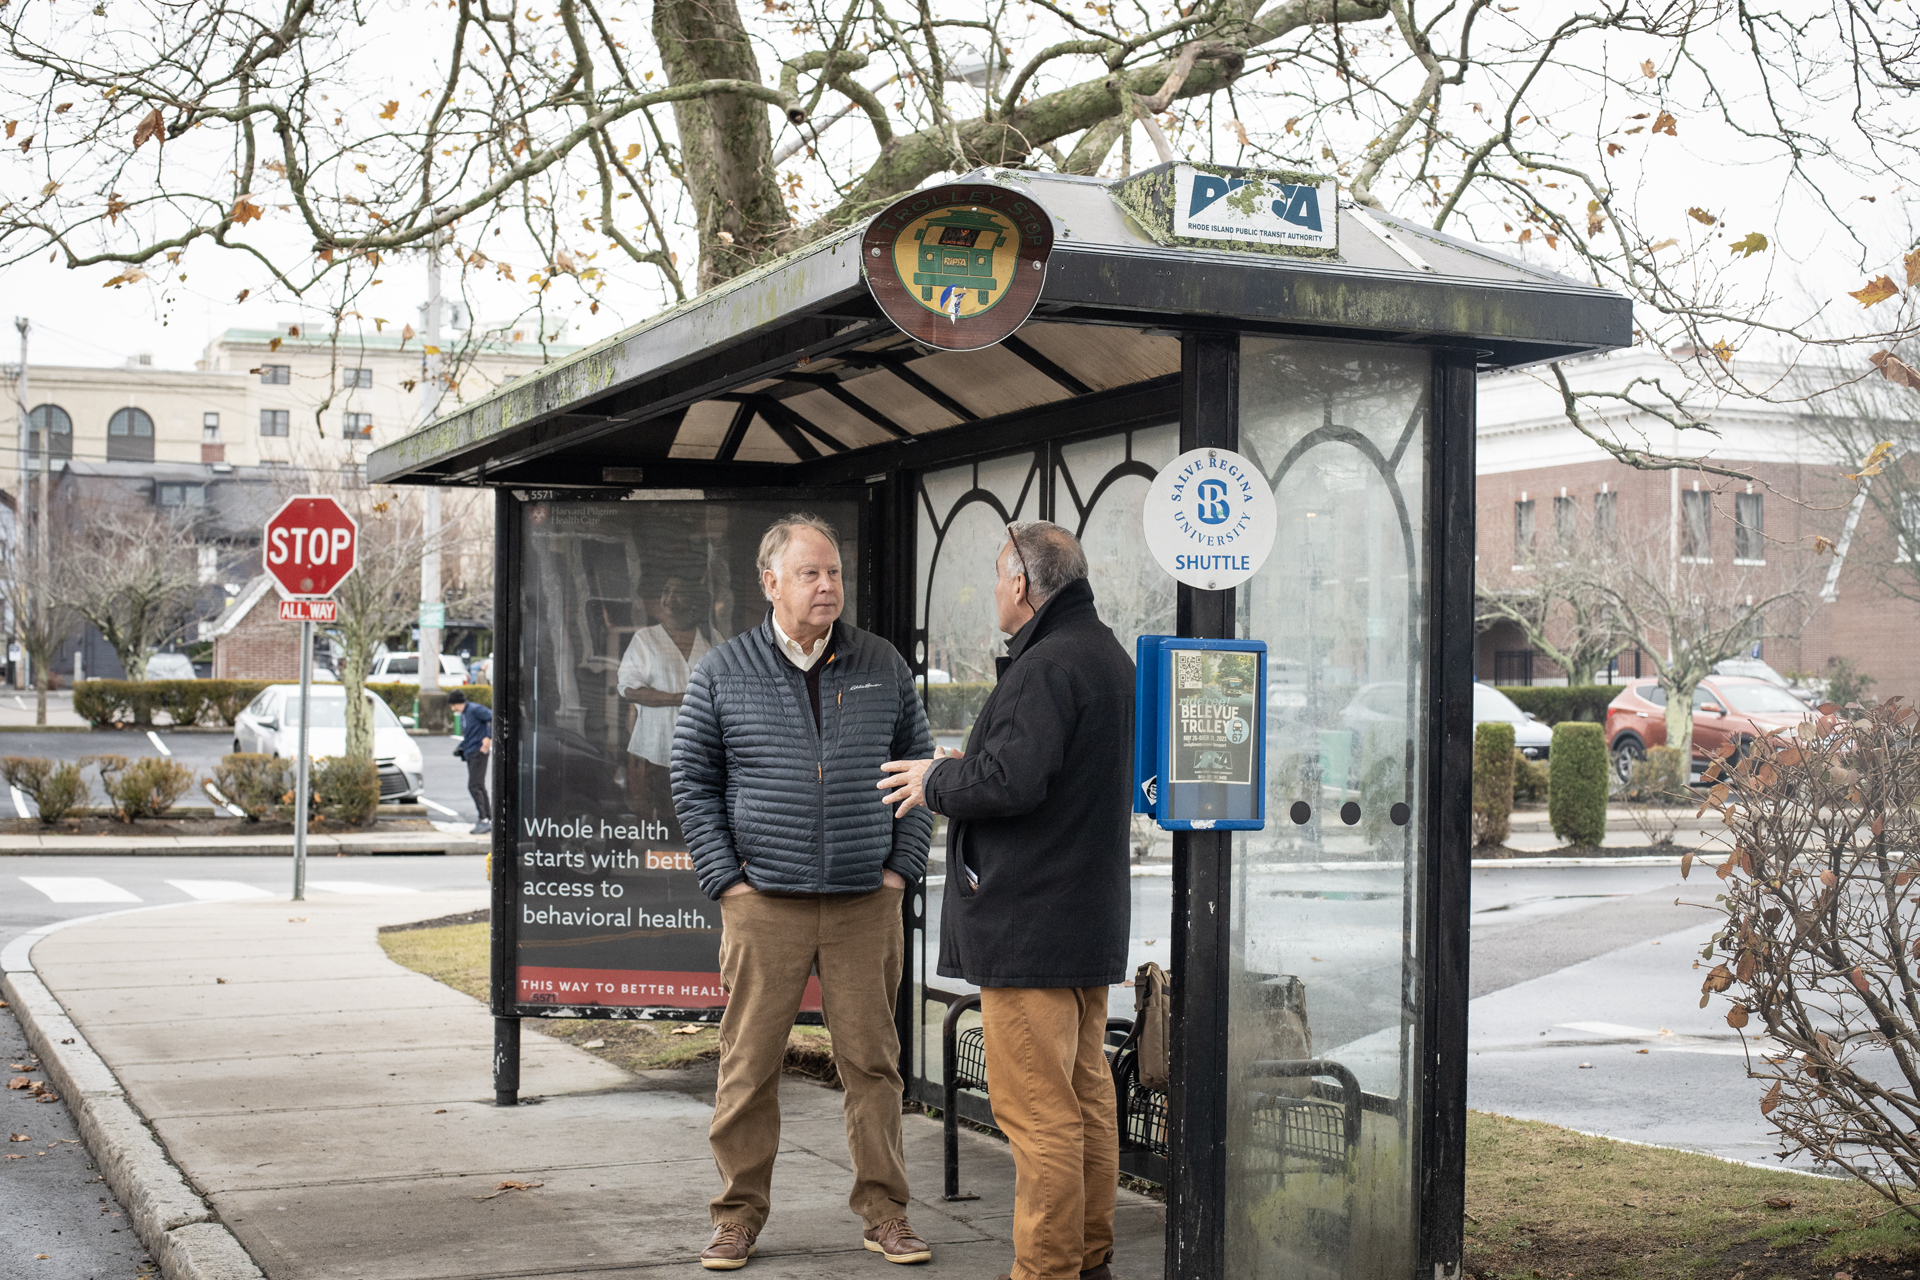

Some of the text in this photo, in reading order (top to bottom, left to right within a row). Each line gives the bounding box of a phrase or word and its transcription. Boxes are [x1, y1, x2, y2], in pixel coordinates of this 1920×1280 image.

[877, 191, 1043, 246] TROLLEY STOP
[1188, 223, 1323, 242] RHODE ISLAND PUBLIC TRANSIT AUTHORITY
[1171, 457, 1253, 503] SALVE REGINA
[531, 490, 553, 500] 5571
[551, 506, 618, 518] Harvard Pilgrim
[551, 515, 601, 525] Health Care
[1174, 510, 1252, 547] UNIVERSITY
[269, 527, 351, 565] STOP
[1175, 554, 1250, 570] SHUTTLE
[281, 602, 335, 620] ALL WAY
[1232, 733, 1243, 743] 67
[524, 817, 669, 841] Whole health
[523, 849, 693, 871] starts with bett
[523, 880, 625, 898] access to
[523, 903, 712, 930] behavioral health.
[521, 979, 731, 997] THIS WAY TO BETTER HEALT
[533, 993, 556, 1002] 5571
